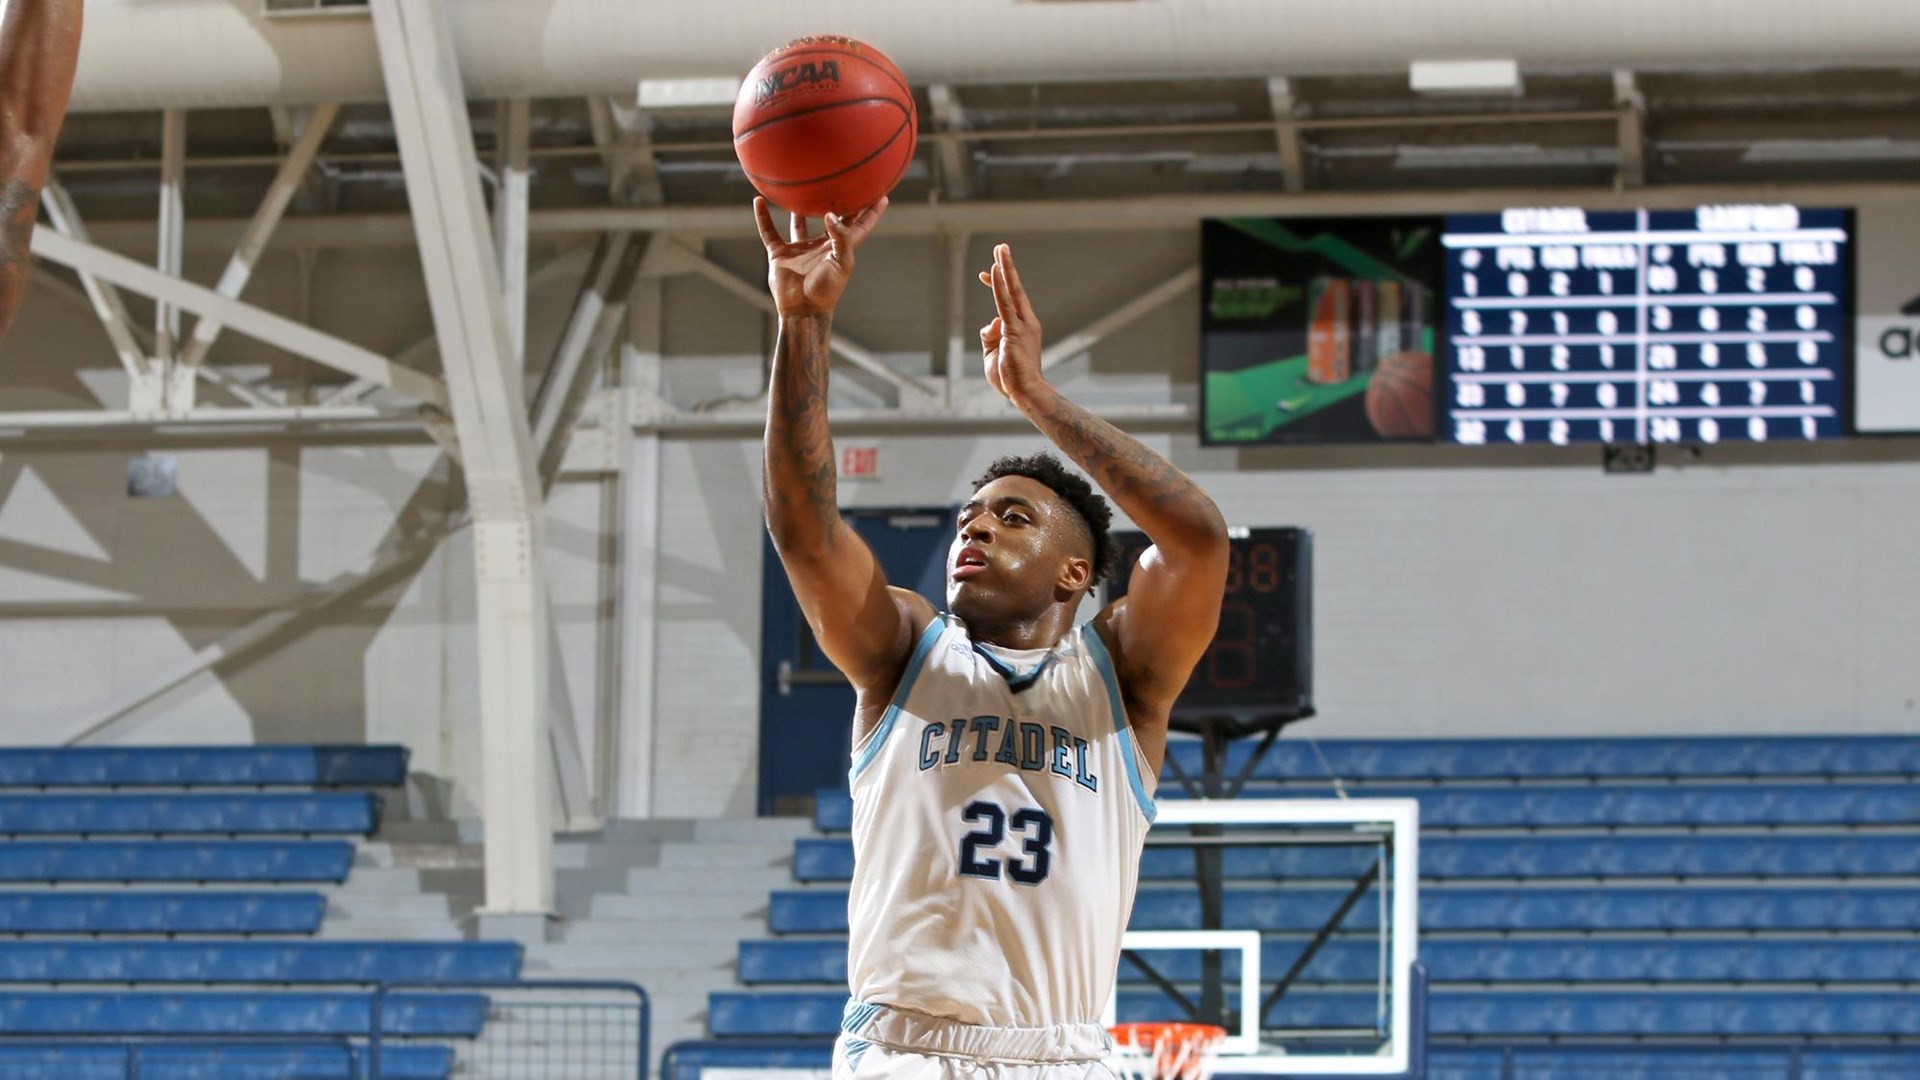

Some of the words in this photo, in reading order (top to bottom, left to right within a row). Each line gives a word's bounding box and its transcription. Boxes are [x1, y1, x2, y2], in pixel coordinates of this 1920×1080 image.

[755, 60, 841, 103] NCAA
[1878, 326, 1920, 359] a
[842, 447, 878, 476] EXIT
[918, 715, 1098, 793] CITADEL
[959, 801, 1053, 885] 23
